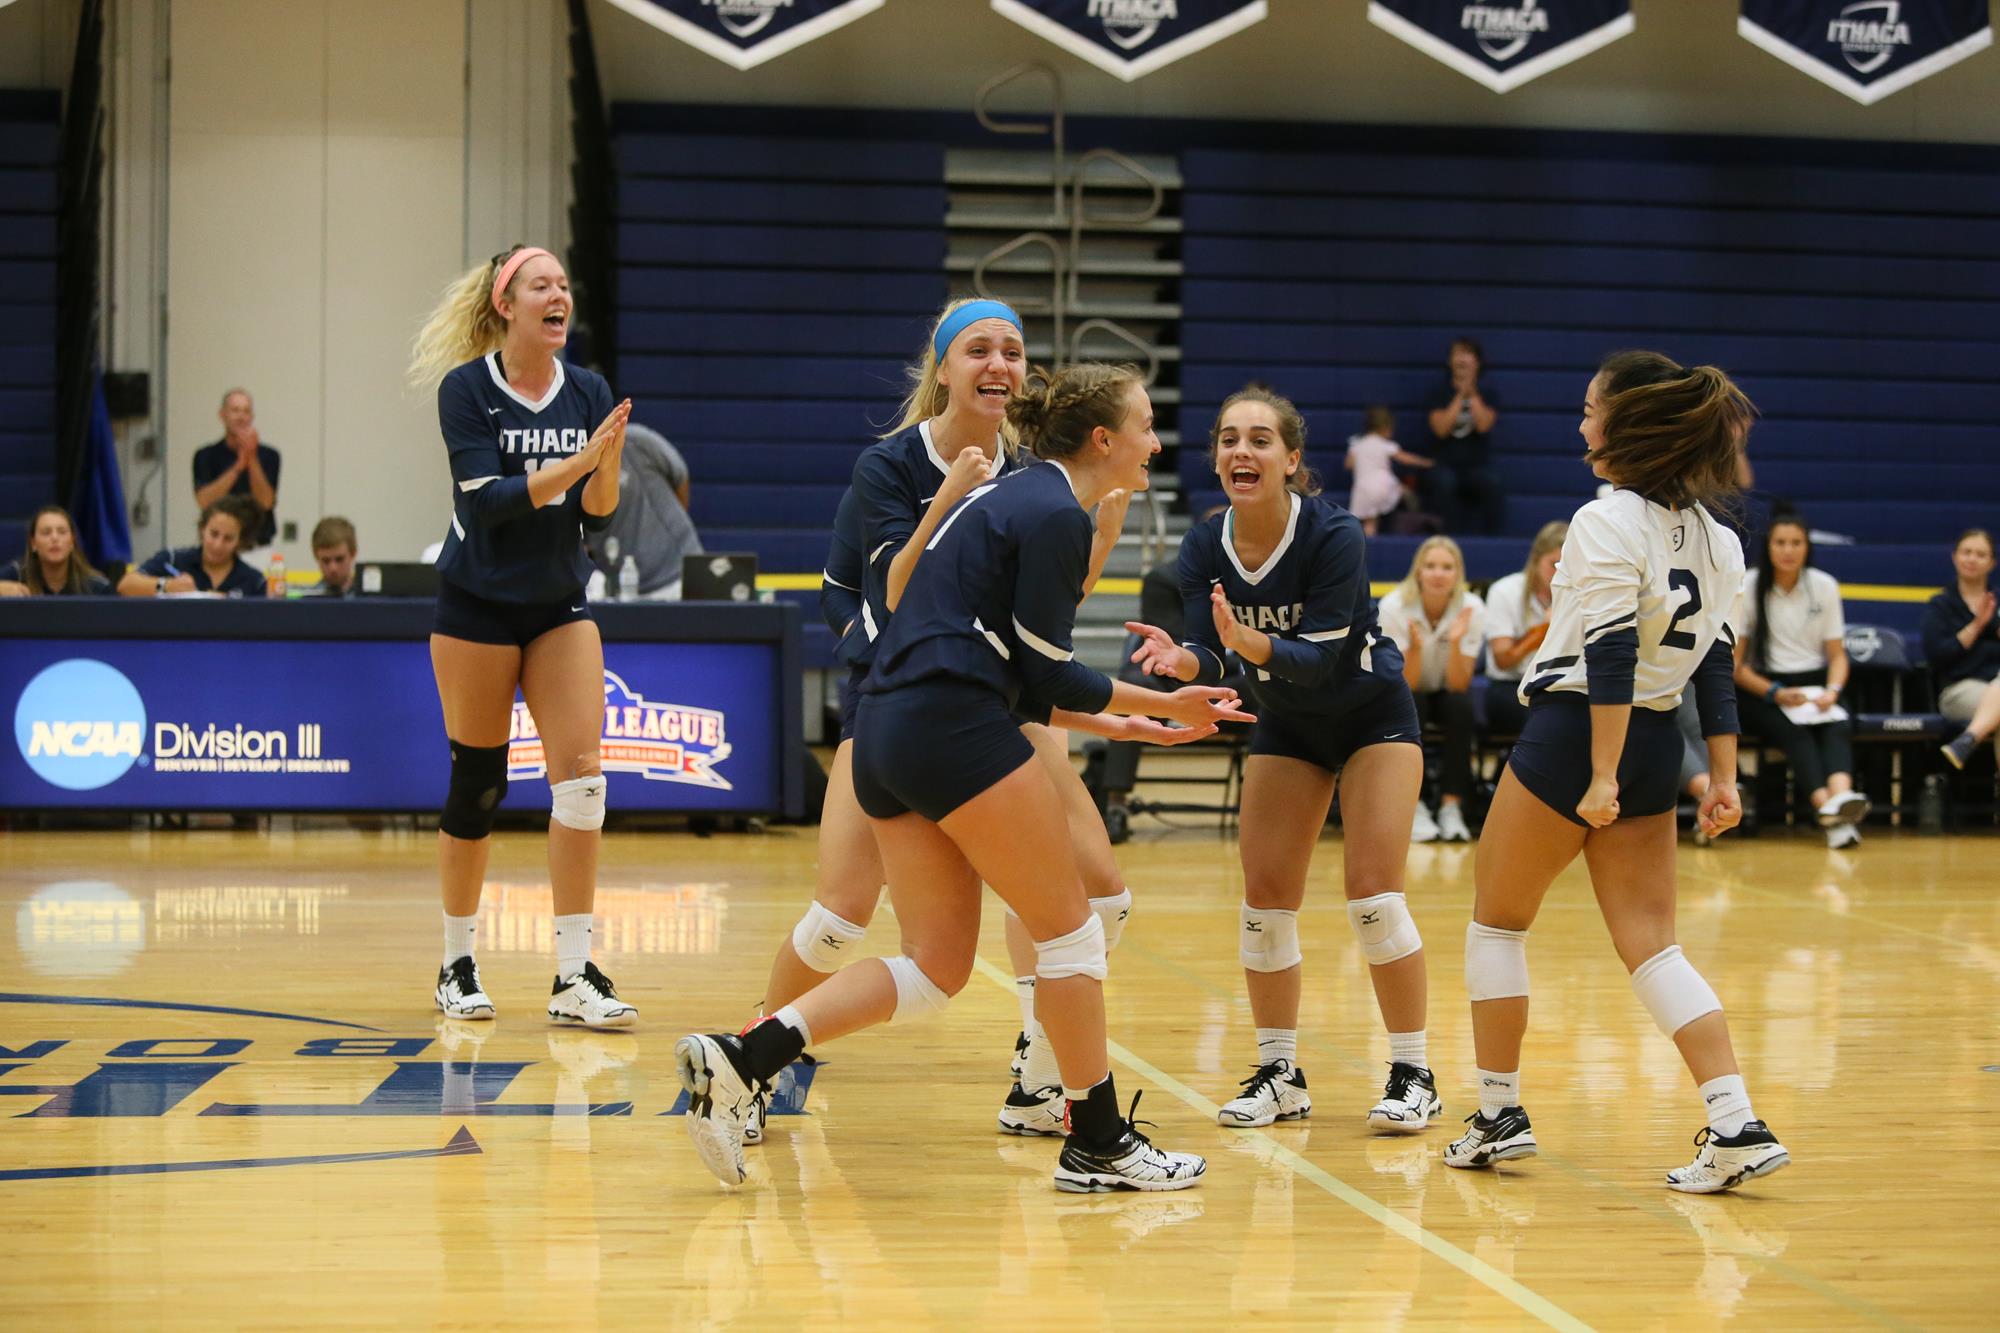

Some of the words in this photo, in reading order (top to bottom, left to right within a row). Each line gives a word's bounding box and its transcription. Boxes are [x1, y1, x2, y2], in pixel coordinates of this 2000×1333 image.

[1461, 5, 1549, 32] ITHACA
[1827, 20, 1911, 45] ITHACA
[1659, 568, 1702, 650] 2
[28, 720, 140, 758] NCAA
[154, 722, 287, 758] Division
[298, 723, 321, 758] III
[605, 705, 720, 747] LEAGUE
